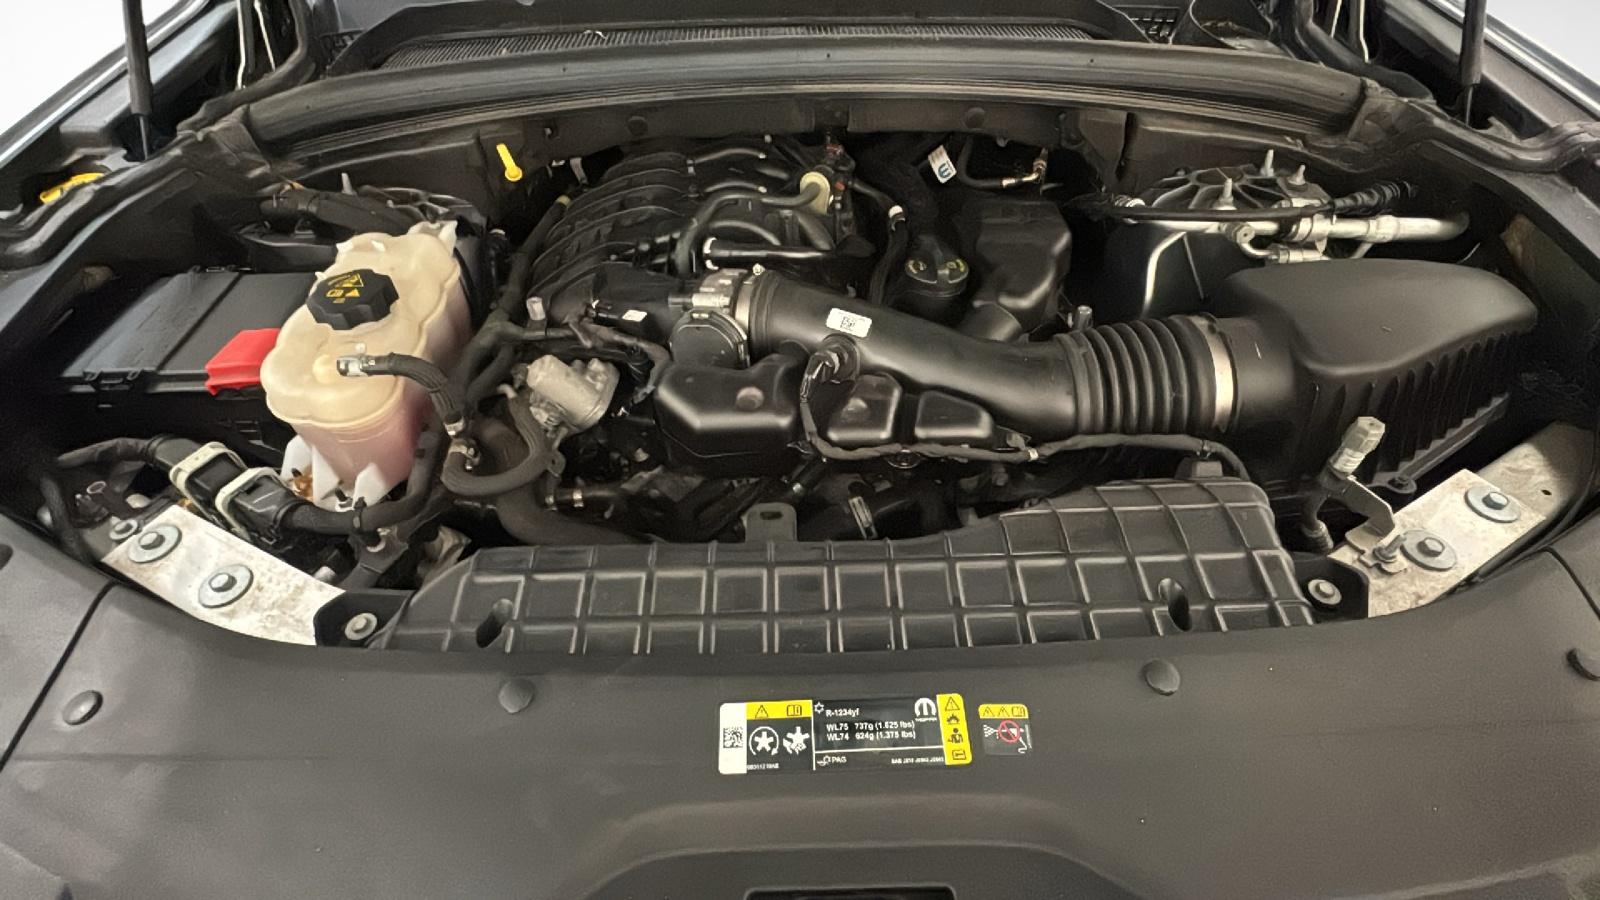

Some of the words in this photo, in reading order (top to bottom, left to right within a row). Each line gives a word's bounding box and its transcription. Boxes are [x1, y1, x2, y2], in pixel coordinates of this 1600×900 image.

[825, 708, 859, 717] R-1234yf
[826, 723, 849, 732] WL75
[854, 722, 874, 731] 737g
[875, 721, 899, 730] (1.625
[900, 720, 915, 729] lbs)
[827, 732, 849, 741] WL74
[855, 731, 875, 741] 624g
[876, 731, 899, 740] (1.375
[901, 730, 916, 739] lbs)
